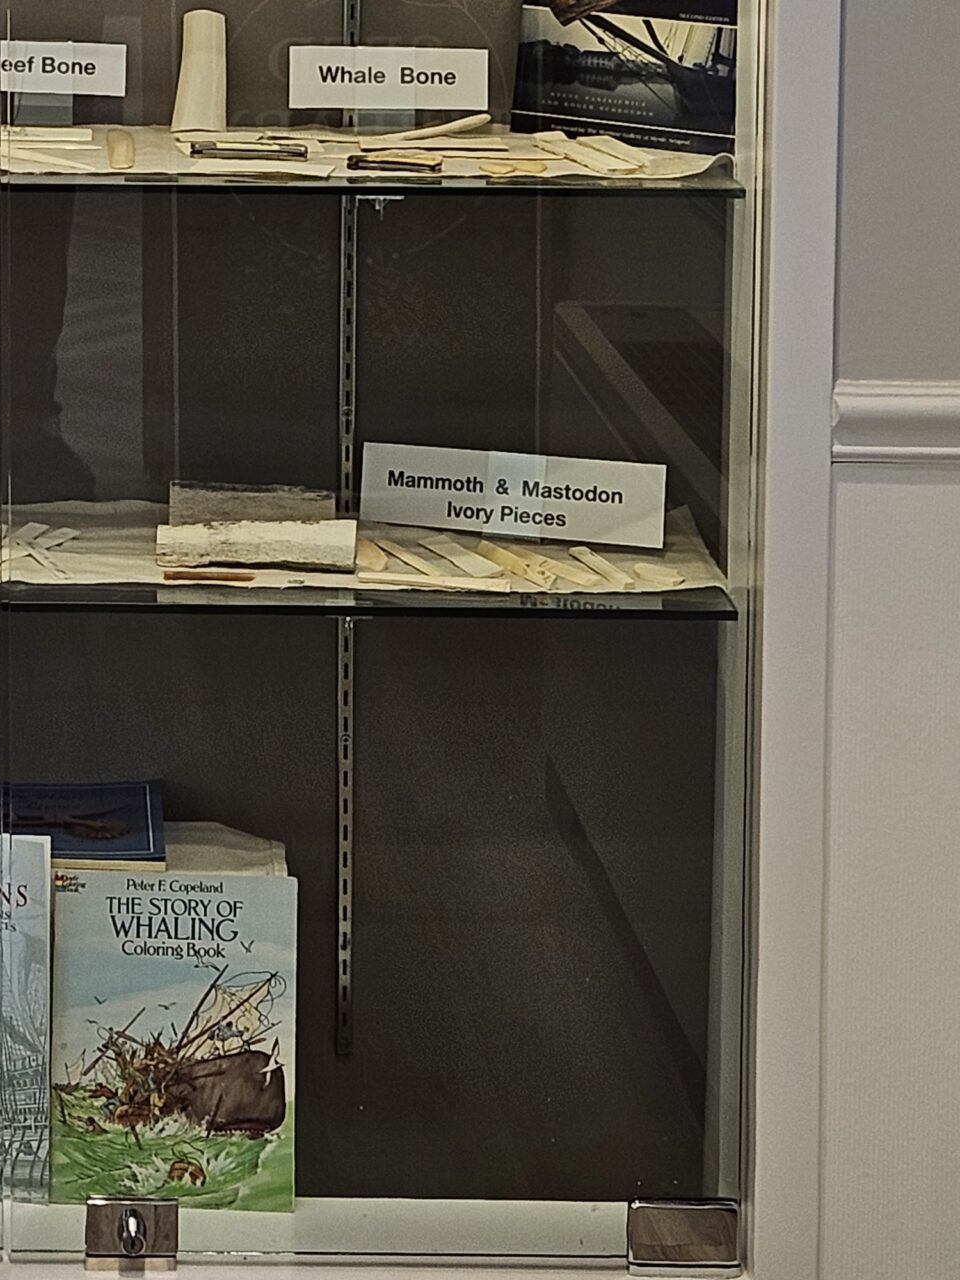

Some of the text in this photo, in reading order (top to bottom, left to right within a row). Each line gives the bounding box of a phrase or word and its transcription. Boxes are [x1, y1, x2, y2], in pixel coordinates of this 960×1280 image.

[41, 55, 97, 77] Bone
[318, 64, 457, 87] Whale Bone
[387, 468, 624, 505] Mammoth & Mastodon
[446, 501, 567, 529] Ivory Pieces
[126, 878, 224, 896] Peter F. Copeland
[105, 897, 244, 918] THE STORY OF
[111, 915, 239, 942] WHALING
[121, 940, 226, 960] Coloring Book
